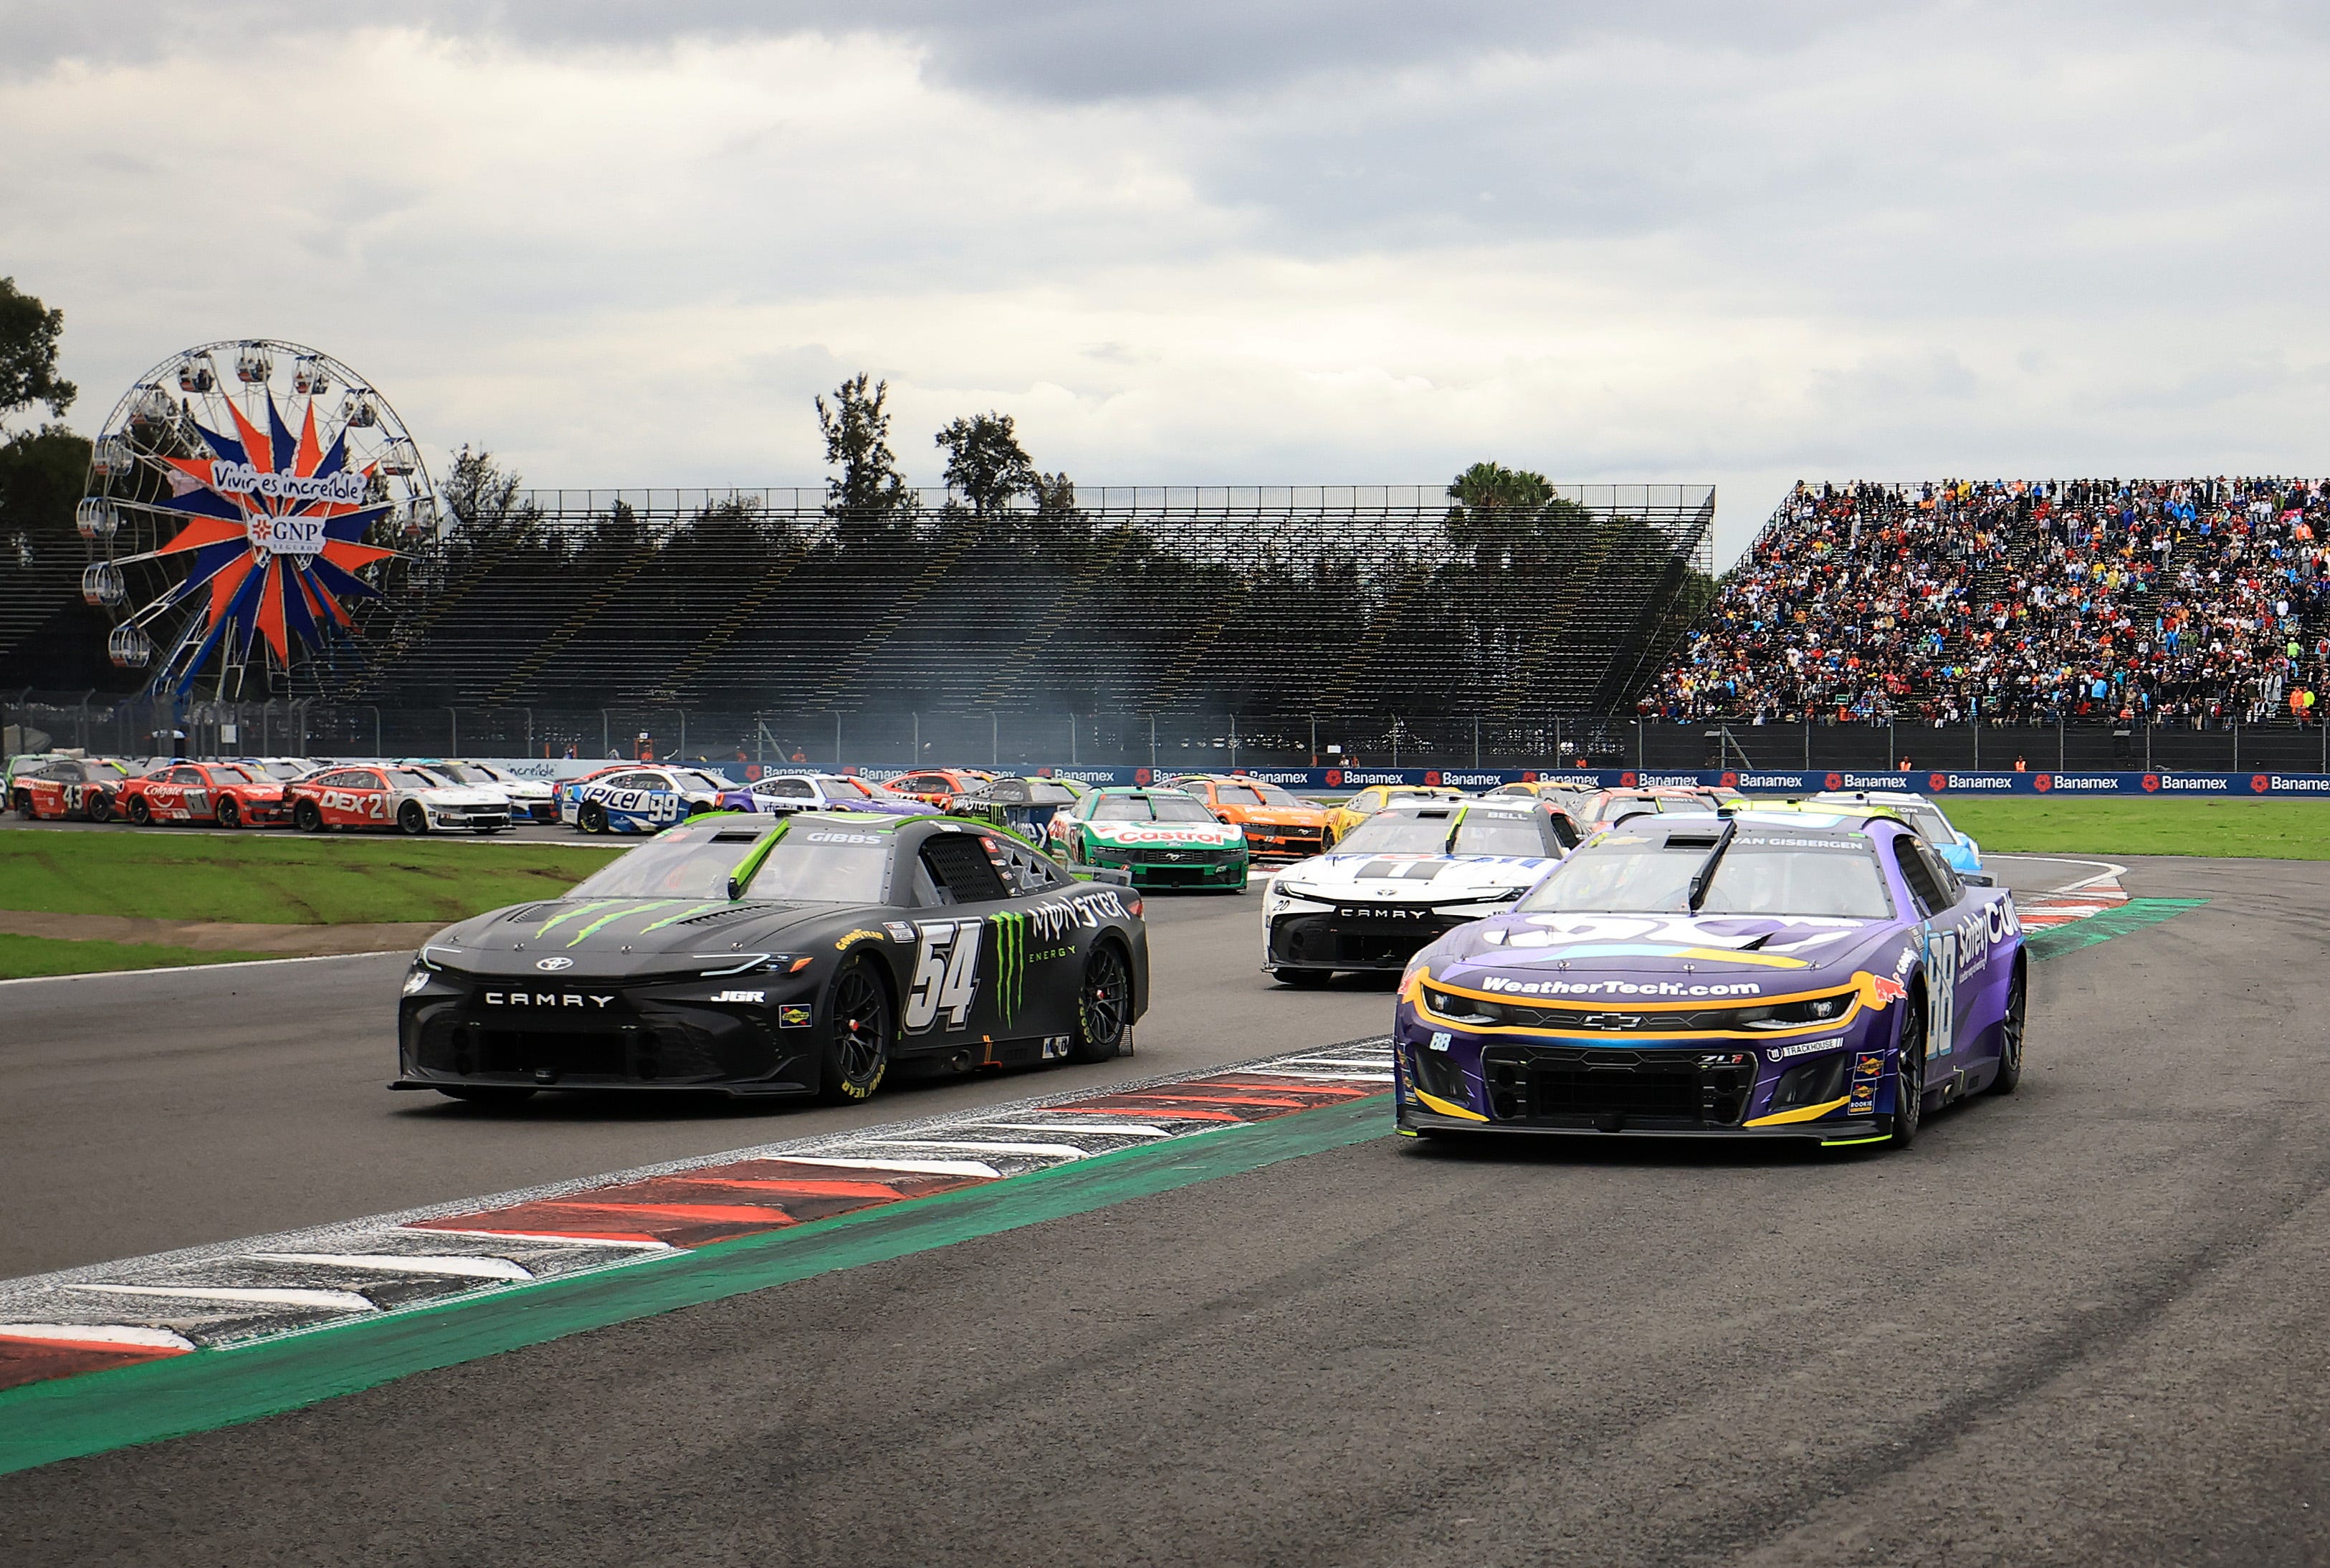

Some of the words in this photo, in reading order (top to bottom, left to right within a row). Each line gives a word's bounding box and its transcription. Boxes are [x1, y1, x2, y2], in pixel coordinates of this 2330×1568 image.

[215, 467, 254, 489] Vivir
[262, 479, 277, 492] es
[274, 521, 317, 541] GNP
[1054, 769, 1114, 782] Banamex
[1249, 770, 1308, 784] Banamex
[1344, 771, 1403, 785] Banamex
[1442, 772, 1501, 786] Banamex
[1539, 772, 1600, 787] Banamex
[1639, 773, 1699, 787] Banamex
[1739, 773, 1803, 788] Banamex
[1844, 774, 1906, 788] Banamex
[1949, 774, 2012, 788] Banamex
[2054, 775, 2119, 789] Banamex
[2162, 775, 2228, 790] Banamex
[63, 785, 83, 809] 43
[143, 784, 183, 798] Colgate
[319, 790, 367, 814] DEX
[368, 793, 393, 818] 21
[648, 793, 679, 822] 99
[1487, 811, 1527, 821] BELL
[806, 832, 882, 845] GIBBS
[1119, 832, 1222, 843] Castrol
[1769, 838, 1863, 851] GISBERGEN
[1272, 899, 1290, 911] 20
[1028, 890, 1131, 942] MONSTER
[1340, 908, 1426, 920] CAMRY
[835, 928, 884, 951] GOODYEAR
[1029, 945, 1076, 963] ENERGY
[902, 917, 985, 1036] 54
[1482, 975, 1762, 997] WeatherTech.com
[485, 993, 616, 1008] CAMRY
[710, 990, 765, 1003] JGR
[1924, 929, 1956, 1061] 88
[1429, 1032, 1452, 1051] 88
[1787, 1041, 1835, 1055] TRACKHOUSE
